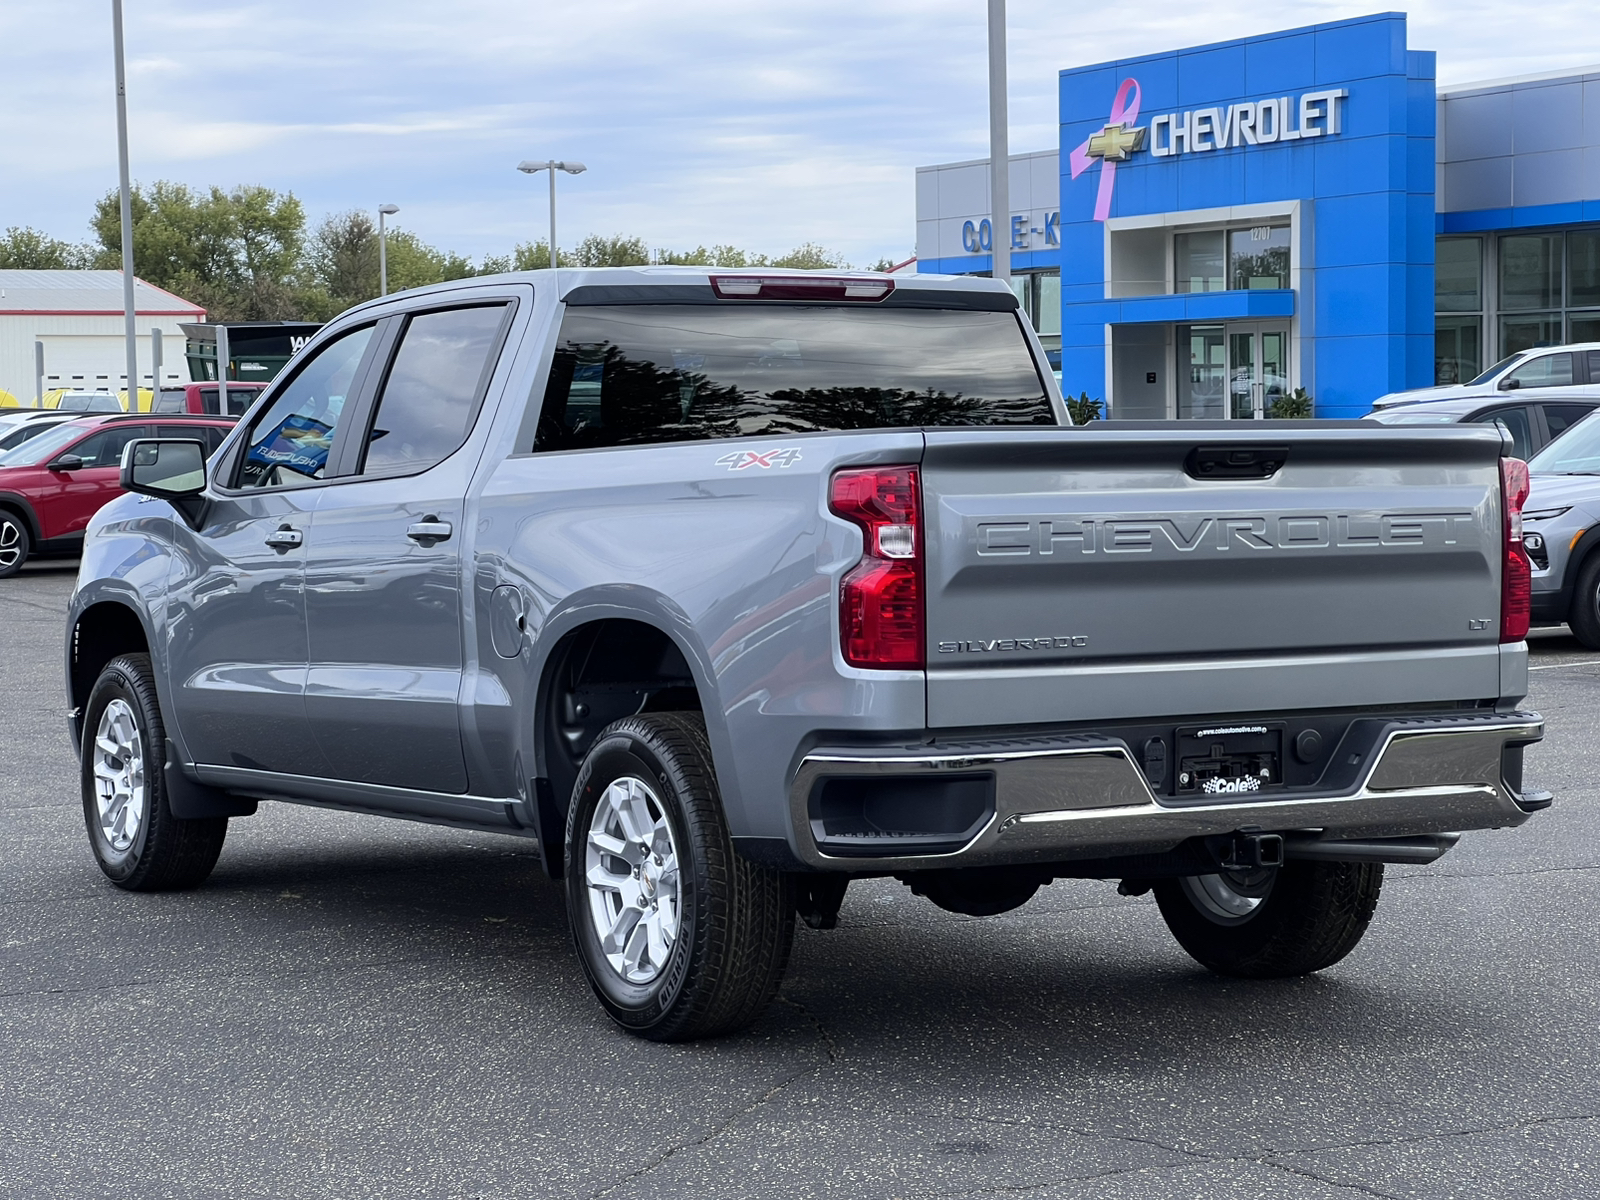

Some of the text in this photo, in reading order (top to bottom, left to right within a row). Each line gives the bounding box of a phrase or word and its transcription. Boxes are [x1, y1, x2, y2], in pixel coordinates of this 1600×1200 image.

[1149, 88, 1349, 157] CHEVROLET
[962, 211, 1060, 253] COE-K
[1250, 226, 1271, 241] 12707
[975, 511, 1474, 557] CHEVROLET
[1467, 617, 1492, 633] LT
[937, 634, 1090, 655] SILVERADO
[1201, 726, 1262, 736] www.coleautomotive.com
[1215, 777, 1248, 794] Cole
[660, 929, 690, 1008] MICHELIN
